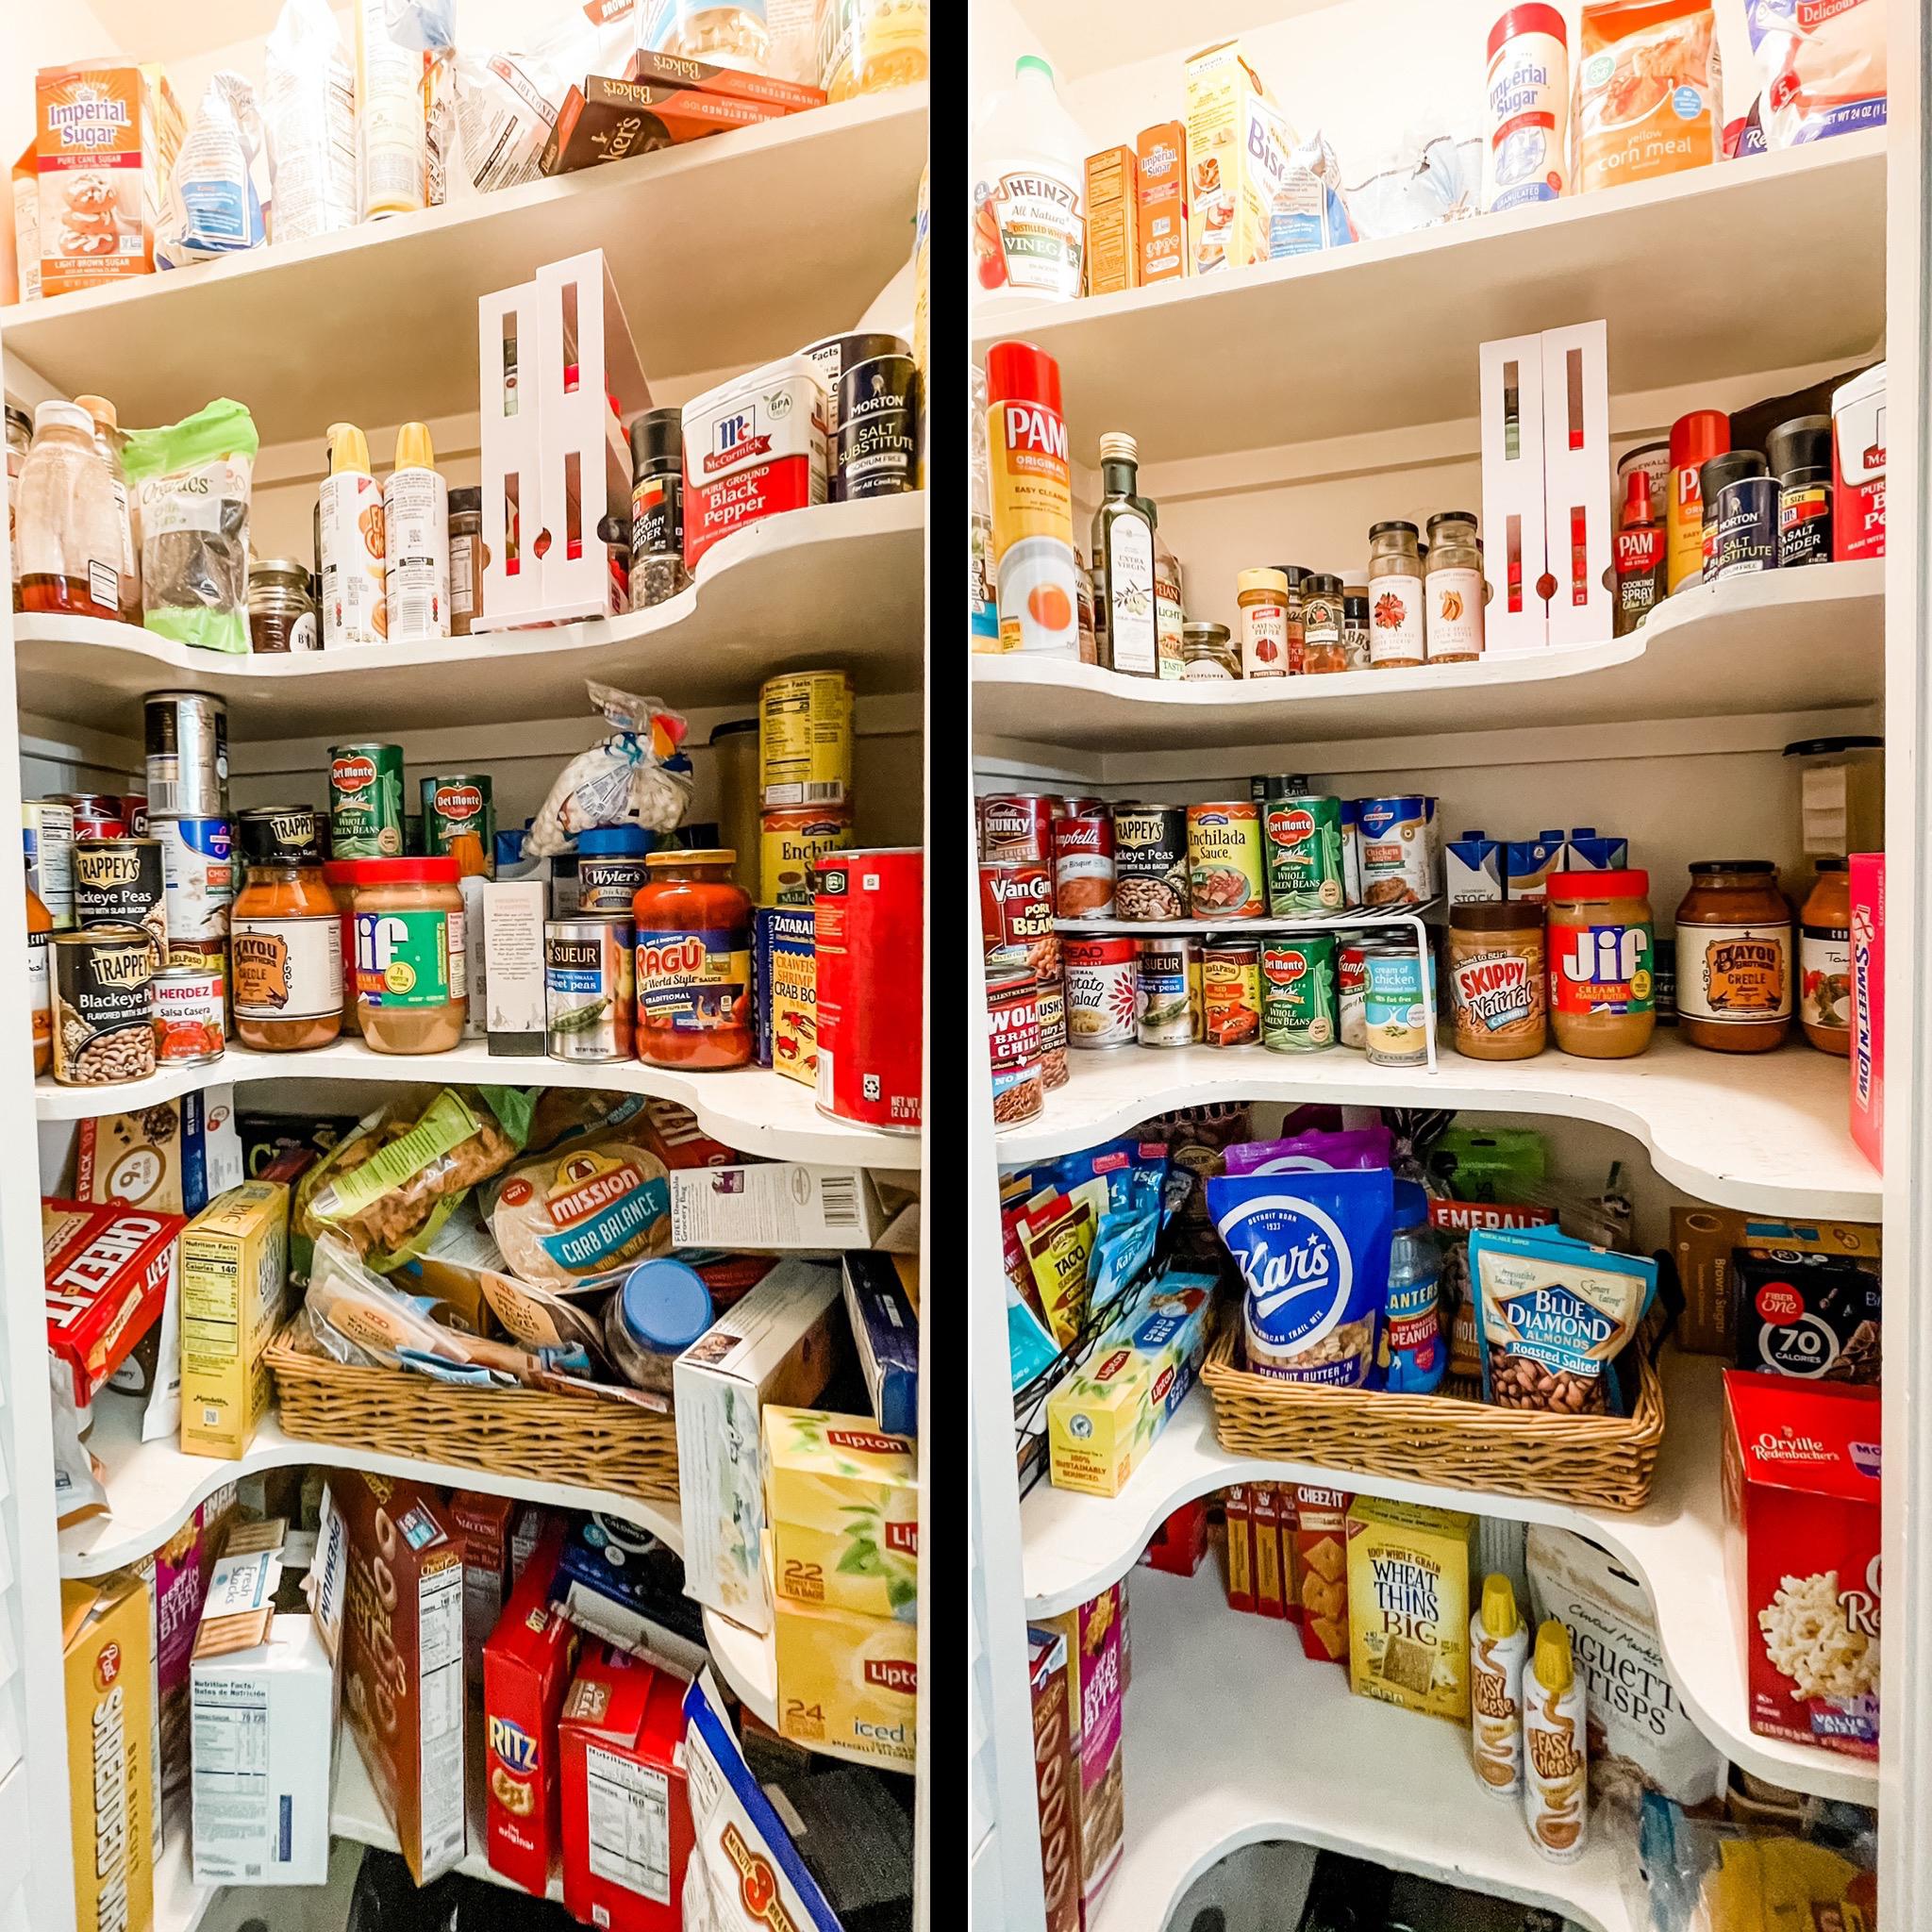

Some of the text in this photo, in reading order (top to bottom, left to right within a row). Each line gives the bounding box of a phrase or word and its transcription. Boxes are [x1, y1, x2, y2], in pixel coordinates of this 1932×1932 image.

[654, 55, 701, 81] Baker's
[604, 80, 652, 105] Baker's
[1490, 65, 1547, 111] Imperial
[50, 100, 125, 126] Imperial
[1496, 90, 1539, 121] Sugar
[62, 125, 115, 146] Sugar
[1627, 128, 1662, 146] yellow
[77, 156, 95, 164] CANE
[98, 155, 122, 163] SUGAR
[1141, 149, 1176, 171] Imperial
[1598, 136, 1691, 172] corn meal
[1147, 163, 1171, 176] Sugar
[1008, 179, 1070, 208] HEINZ
[1011, 206, 1027, 217] All
[1012, 224, 1048, 237] DISTILLED
[1004, 237, 1079, 264] VINEGAR
[55, 258, 130, 269] LIGHT BROWN SUGAR
[771, 397, 791, 412] BPA
[851, 395, 904, 418] MORTON
[859, 423, 895, 441] SALT
[1007, 408, 1069, 465] PAM
[707, 437, 763, 471] McCormick
[840, 436, 914, 466] SUBSTITUTE
[883, 455, 903, 464] FREE
[1015, 455, 1066, 475] ORIGINAL
[701, 467, 769, 498] PURE GROUND
[710, 480, 758, 509] Black
[1790, 493, 1806, 504] SIZE
[704, 496, 766, 527] Pepper
[1720, 512, 1758, 531] MORTON
[1619, 533, 1653, 558] PAM
[1724, 537, 1750, 553] SALT
[1117, 561, 1146, 573] VIRGIN
[1118, 554, 1145, 565] EXTRA
[1622, 578, 1654, 590] COOKING
[1622, 587, 1654, 602] SPRAY
[333, 767, 373, 778] Del Monte
[438, 795, 479, 807] Del Monte
[339, 817, 366, 825] WHOLE
[1117, 818, 1163, 841] TRAPPEY'S
[1269, 820, 1311, 832] Del Monte
[1190, 829, 1246, 846] Enchilada
[1147, 849, 1174, 860] Peas
[1200, 847, 1229, 859] Sauce
[1367, 848, 1399, 857] Chicken
[79, 857, 139, 879] TRAPPEY'S
[591, 868, 640, 885] Wyler's
[1277, 872, 1307, 880] WHOLE
[1271, 878, 1320, 889] GREEN BEANS
[122, 891, 152, 903] Peas
[597, 889, 632, 897] Chicken
[781, 892, 806, 904] Mild
[1024, 903, 1050, 916] PORK
[555, 947, 596, 963] SUEUR
[638, 939, 702, 979] RAGÚ
[1144, 957, 1180, 971] SUEUR
[1562, 928, 1647, 982] Jif
[1715, 944, 1775, 973] BAYOU
[1265, 959, 1304, 971] Del Monte
[1375, 966, 1395, 974] cream
[570, 981, 596, 991] peas
[648, 975, 672, 988] World
[674, 974, 696, 986] Style
[777, 970, 813, 989] SHRIMP
[1066, 975, 1104, 992] Potato
[1375, 973, 1414, 986] chicken
[1461, 962, 1525, 999] SKIPPY
[1727, 972, 1766, 985] CREOLE
[159, 987, 209, 999] HERDEZ
[774, 982, 798, 999] CRAB
[1158, 983, 1180, 993] peas
[1578, 985, 1622, 993] CREAMY
[1602, 991, 1627, 1000] BUTTER
[80, 991, 142, 1008] Blackeye
[645, 992, 691, 1005] TRADITIONAL
[1068, 991, 1104, 1008] Salad
[1470, 982, 1533, 1024] Natural
[87, 1011, 120, 1020] FLAVORED
[1269, 1009, 1297, 1018] WHOLE
[1283, 1017, 1310, 1026] BEANS
[1491, 1008, 1524, 1026] Creamy
[891, 1096, 920, 1108] NET WT
[900, 1108, 908, 1118] LB
[77, 1154, 94, 1191] PACK
[220, 1204, 254, 1224] BIG
[1247, 1212, 1297, 1226] DETROIT BORN
[561, 1228, 602, 1263] CARB
[599, 1191, 659, 1245] BALANCE
[185, 1241, 216, 1251] Nutrition
[186, 1263, 237, 1274] Calories 140
[1054, 1246, 1086, 1277] TACO
[1231, 1241, 1330, 1298] Kar's
[1714, 1258, 1725, 1296] Brown
[1536, 1290, 1586, 1320] BLUE
[1765, 1291, 1793, 1302] FIBER
[1761, 1299, 1796, 1314] One
[1288, 1309, 1324, 1340] TRAIL MIX
[1507, 1303, 1611, 1341] DIAMOND
[1391, 1323, 1438, 1346] PEANUTS
[1525, 1330, 1591, 1351] ALMONDS
[1778, 1328, 1822, 1355] 70
[1097, 1352, 1128, 1380] Lipton
[1512, 1341, 1600, 1374] Roasted Salted
[1774, 1352, 1822, 1364] CALORIES
[1303, 1365, 1340, 1381] BUTTER
[1152, 1369, 1174, 1404] Lipton
[834, 1431, 903, 1451] Lipton
[1759, 1433, 1824, 1454] Orville
[1751, 1443, 1840, 1461] Redenbacher's
[1055, 1459, 1107, 1474] SUSTAINABLY
[1061, 1470, 1099, 1481] SOURCED
[1297, 1486, 1344, 1507] CHEEZ-IT
[785, 1559, 824, 1579] 22
[1385, 1548, 1441, 1574] WHOLE GRAIN
[243, 1564, 258, 1597] Fresh
[321, 1519, 341, 1626] PREMIUM
[1372, 1558, 1440, 1593] WHEAT
[225, 1566, 244, 1604] Stacks
[788, 1699, 825, 1721] 24
[854, 1717, 905, 1742] iced
[488, 1714, 540, 1772] RITZ
[1537, 1730, 1574, 1761] EASY
[127, 1741, 137, 1782] BIG
[93, 1688, 125, 1880] SHREDDED
[498, 1825, 535, 1852] original
[727, 1831, 753, 1875] MINUTE
